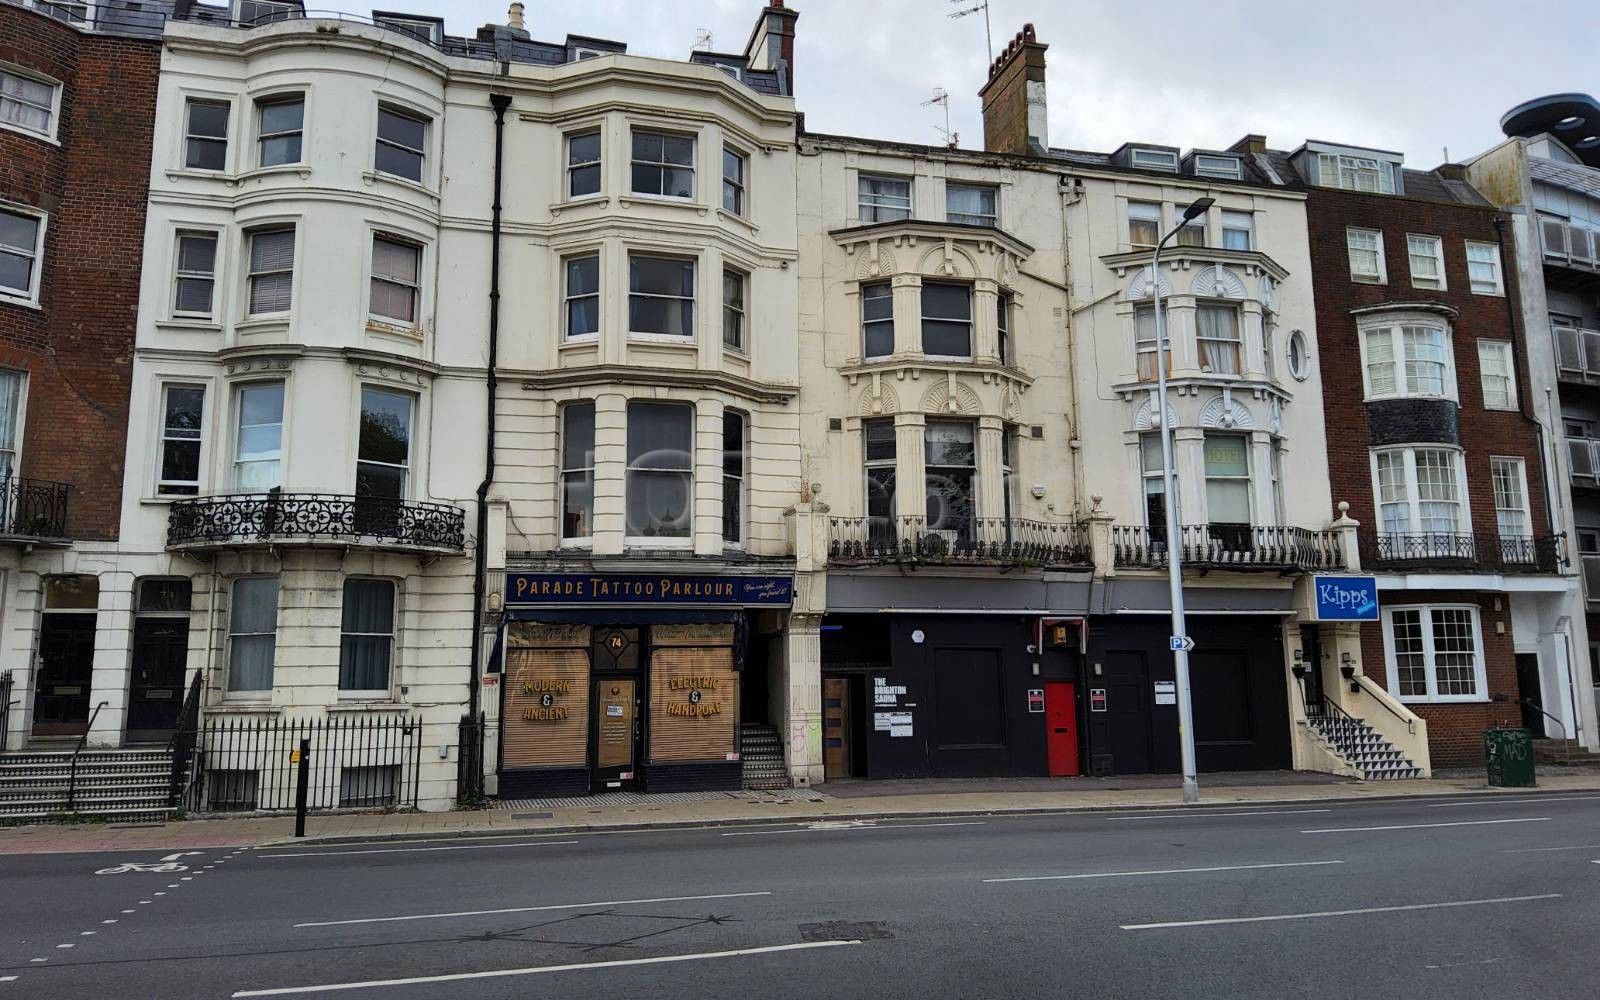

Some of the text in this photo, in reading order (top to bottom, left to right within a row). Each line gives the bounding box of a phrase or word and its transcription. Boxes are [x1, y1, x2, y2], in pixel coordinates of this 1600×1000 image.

[516, 577, 734, 598] PARADE TATTOO PARLOUR
[1319, 584, 1368, 610] Kipps
[611, 637, 623, 649] 74
[1172, 638, 1182, 648] P
[523, 679, 571, 694] MODERN
[670, 676, 720, 690] ELECTRIC
[874, 677, 887, 686] THE
[874, 685, 907, 695] BRIGHTON
[522, 706, 569, 720] ANCIENT
